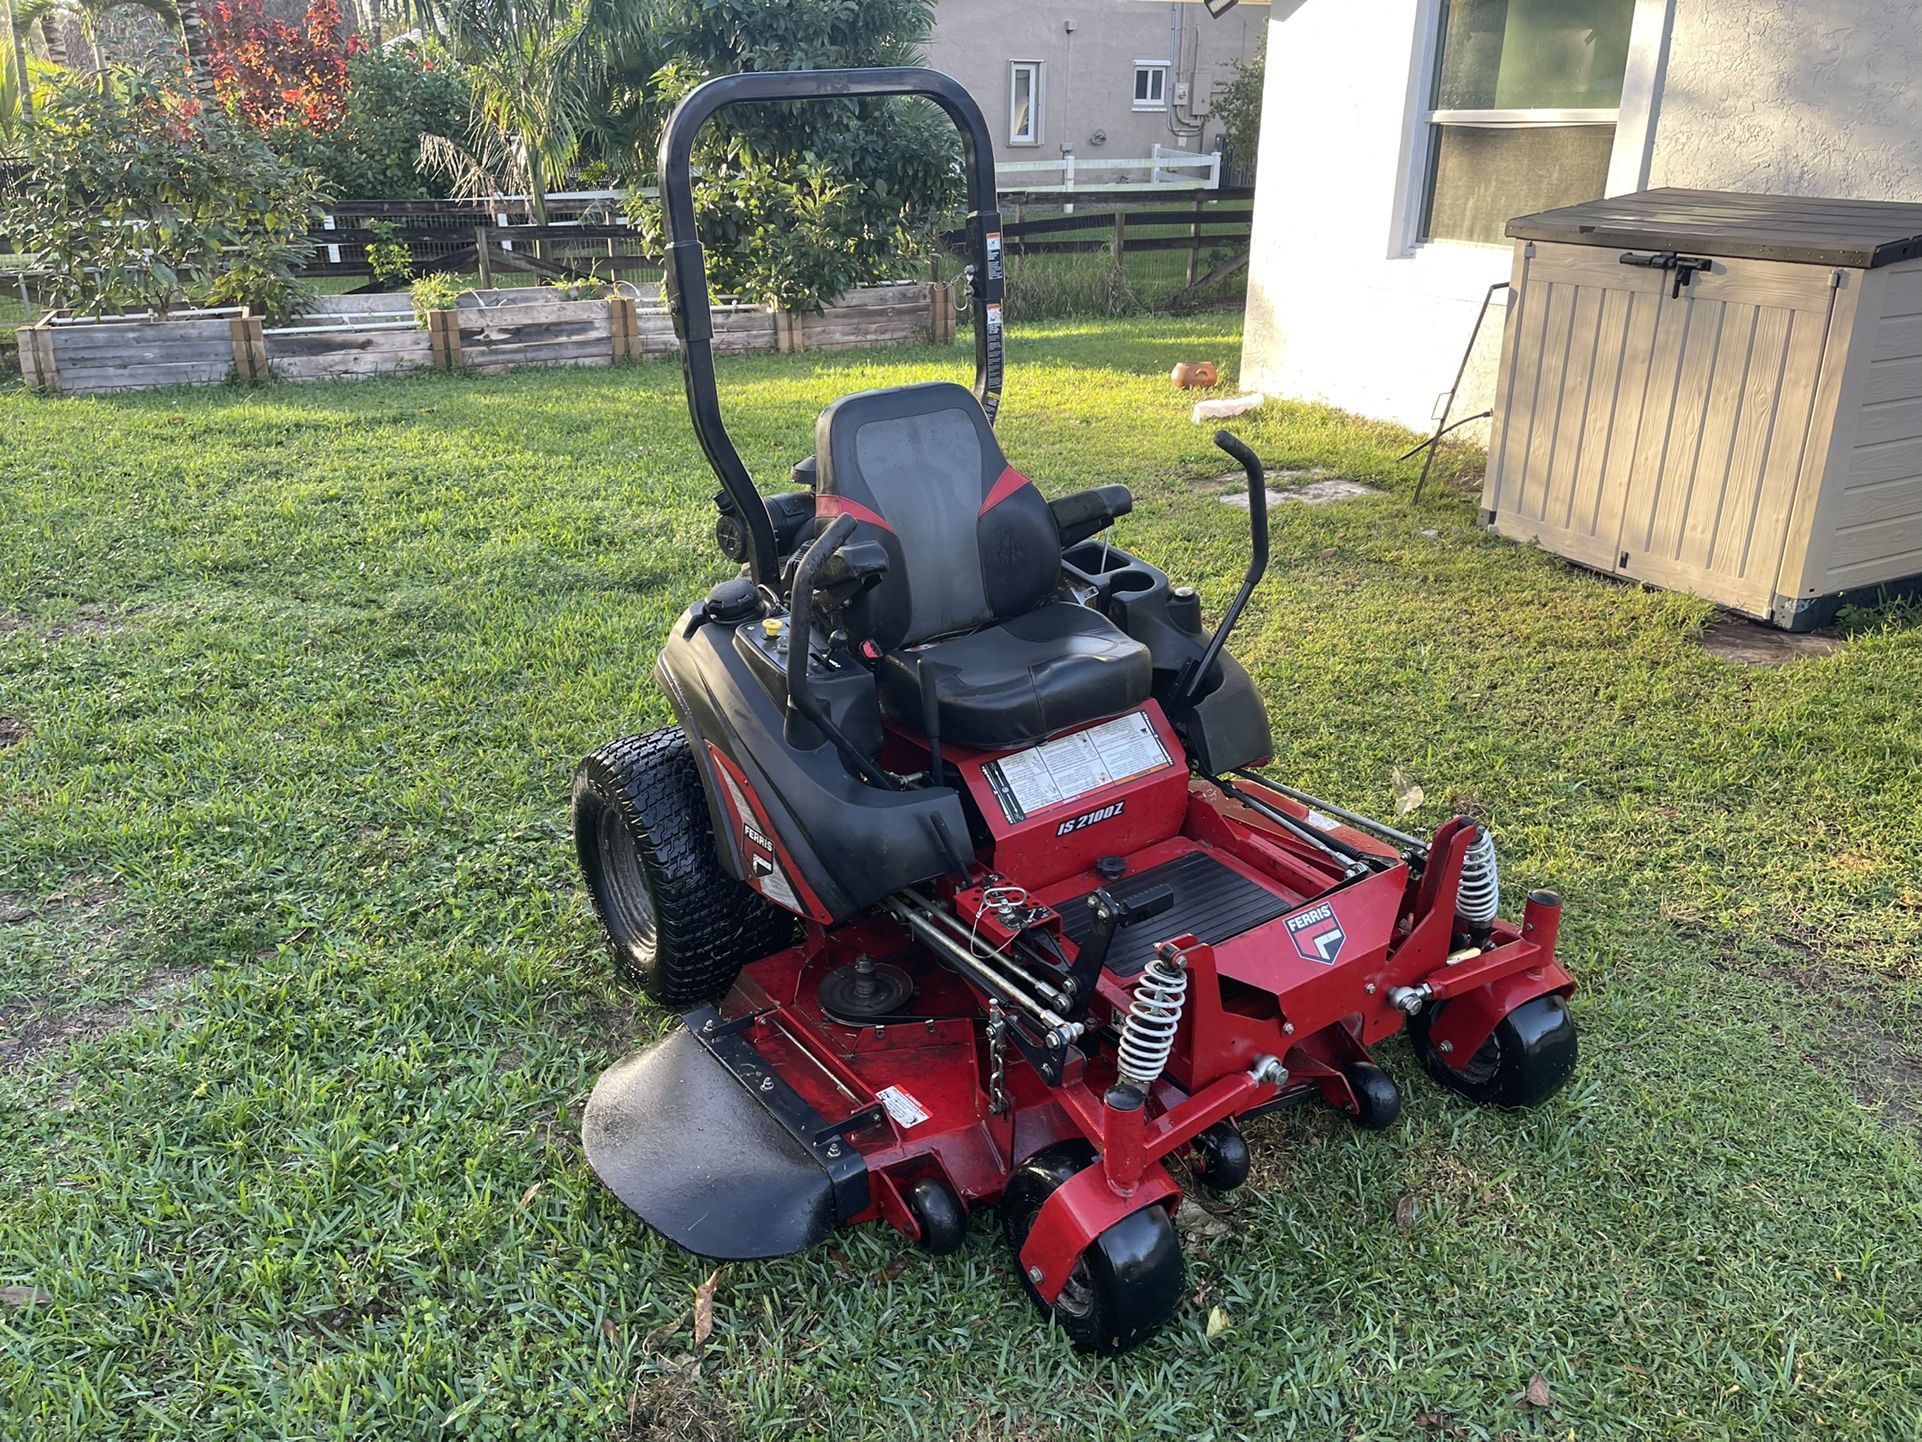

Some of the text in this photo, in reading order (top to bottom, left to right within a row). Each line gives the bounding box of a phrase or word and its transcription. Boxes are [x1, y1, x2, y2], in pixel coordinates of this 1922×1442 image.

[1057, 801, 1125, 837] IS 2100Z
[744, 824, 773, 852] FERRIS
[1287, 904, 1331, 932] FERRIS
